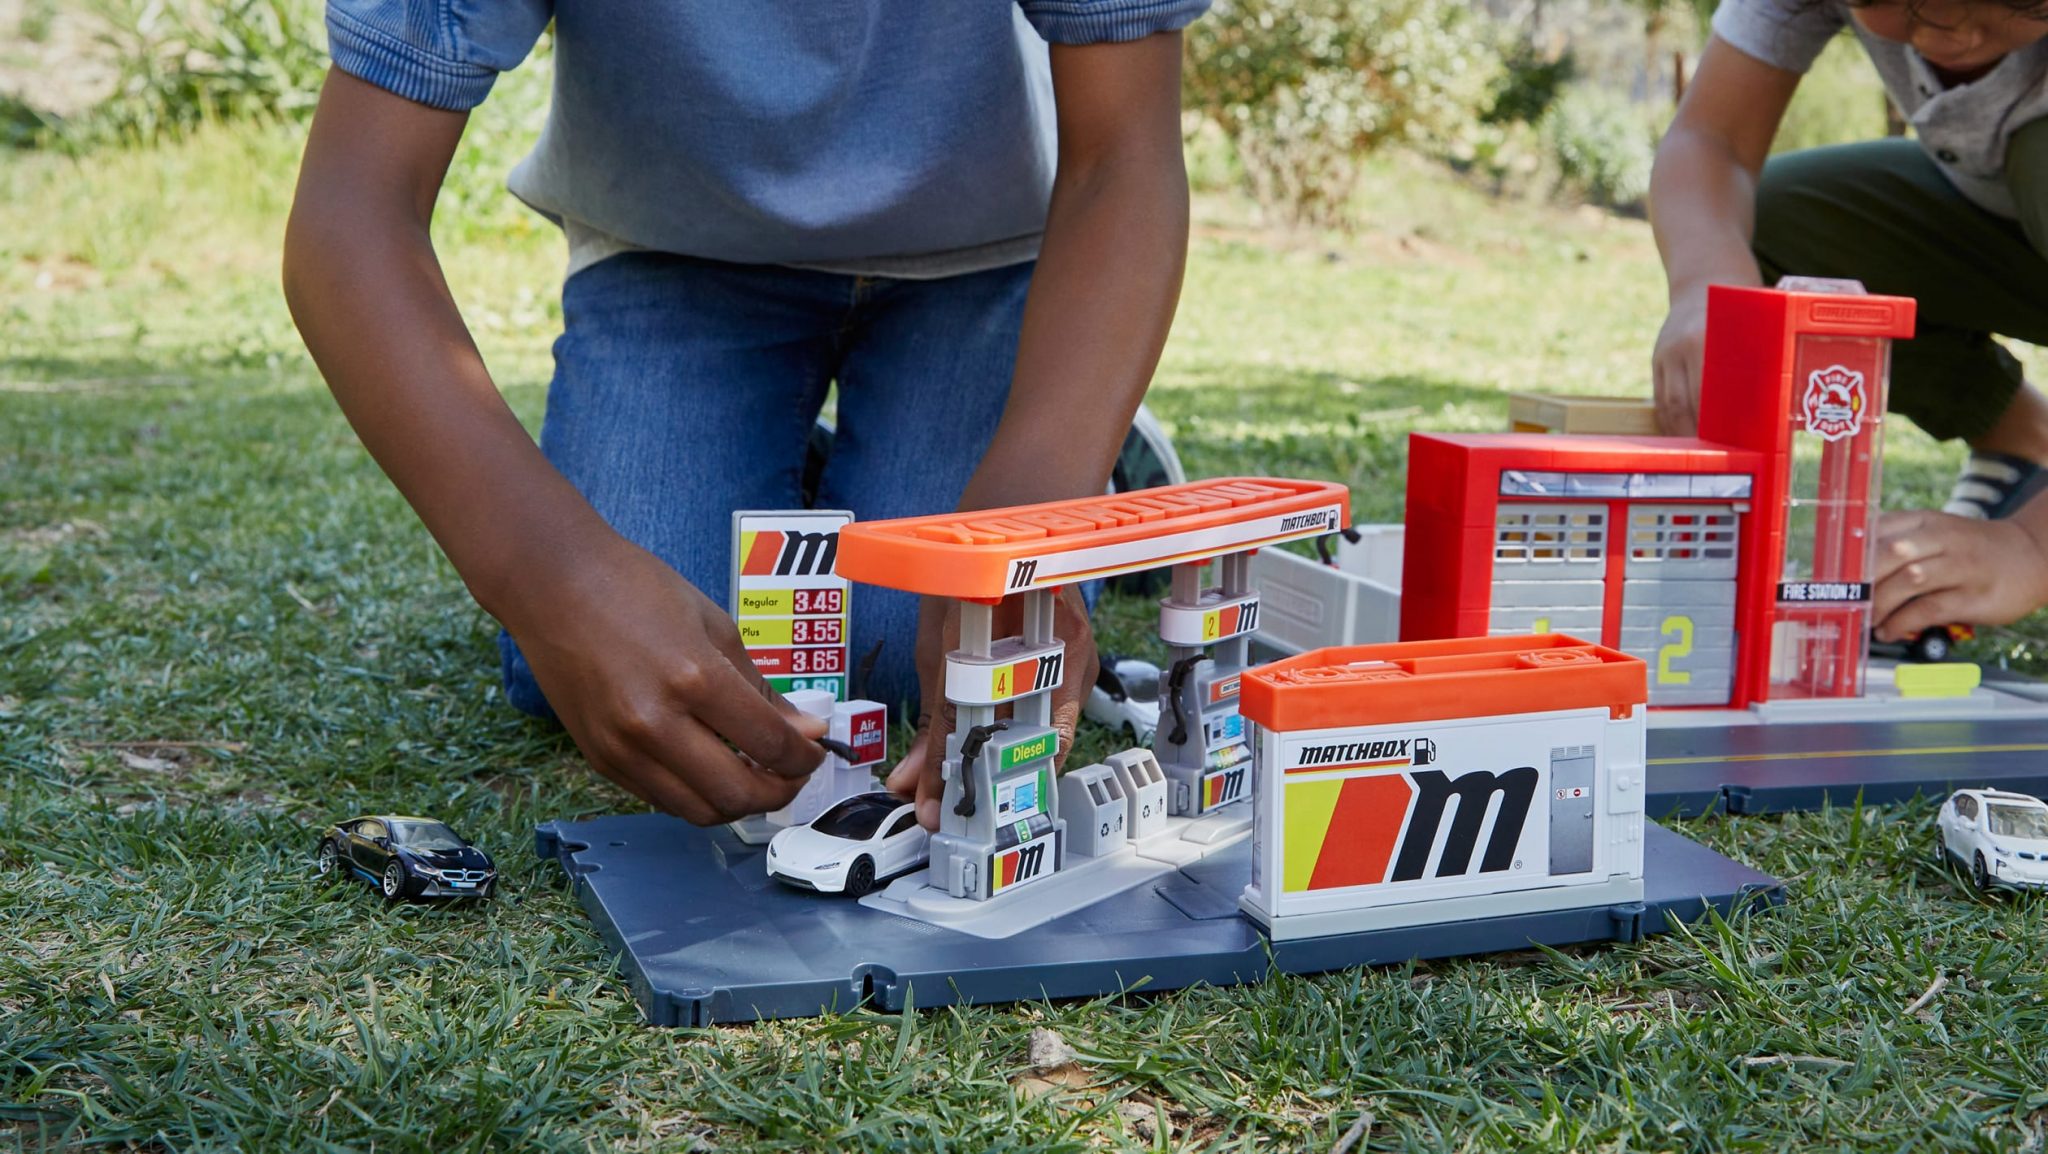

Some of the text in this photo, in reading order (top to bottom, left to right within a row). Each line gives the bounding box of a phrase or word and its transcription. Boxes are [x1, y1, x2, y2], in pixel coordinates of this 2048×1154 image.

[1281, 511, 1328, 531] MATCHBOX
[743, 591, 841, 612] Regular 3.49
[1783, 584, 1861, 599] FIRE STATION 21
[743, 620, 840, 642] Plus 3.55
[1208, 616, 1214, 637] 2
[752, 650, 839, 672] mium 3.65
[1657, 616, 1694, 684] 2
[997, 672, 1006, 695] 4
[860, 720, 876, 732] Air
[1013, 739, 1045, 763] Diesel
[1299, 739, 1411, 765] MATCHBOX
